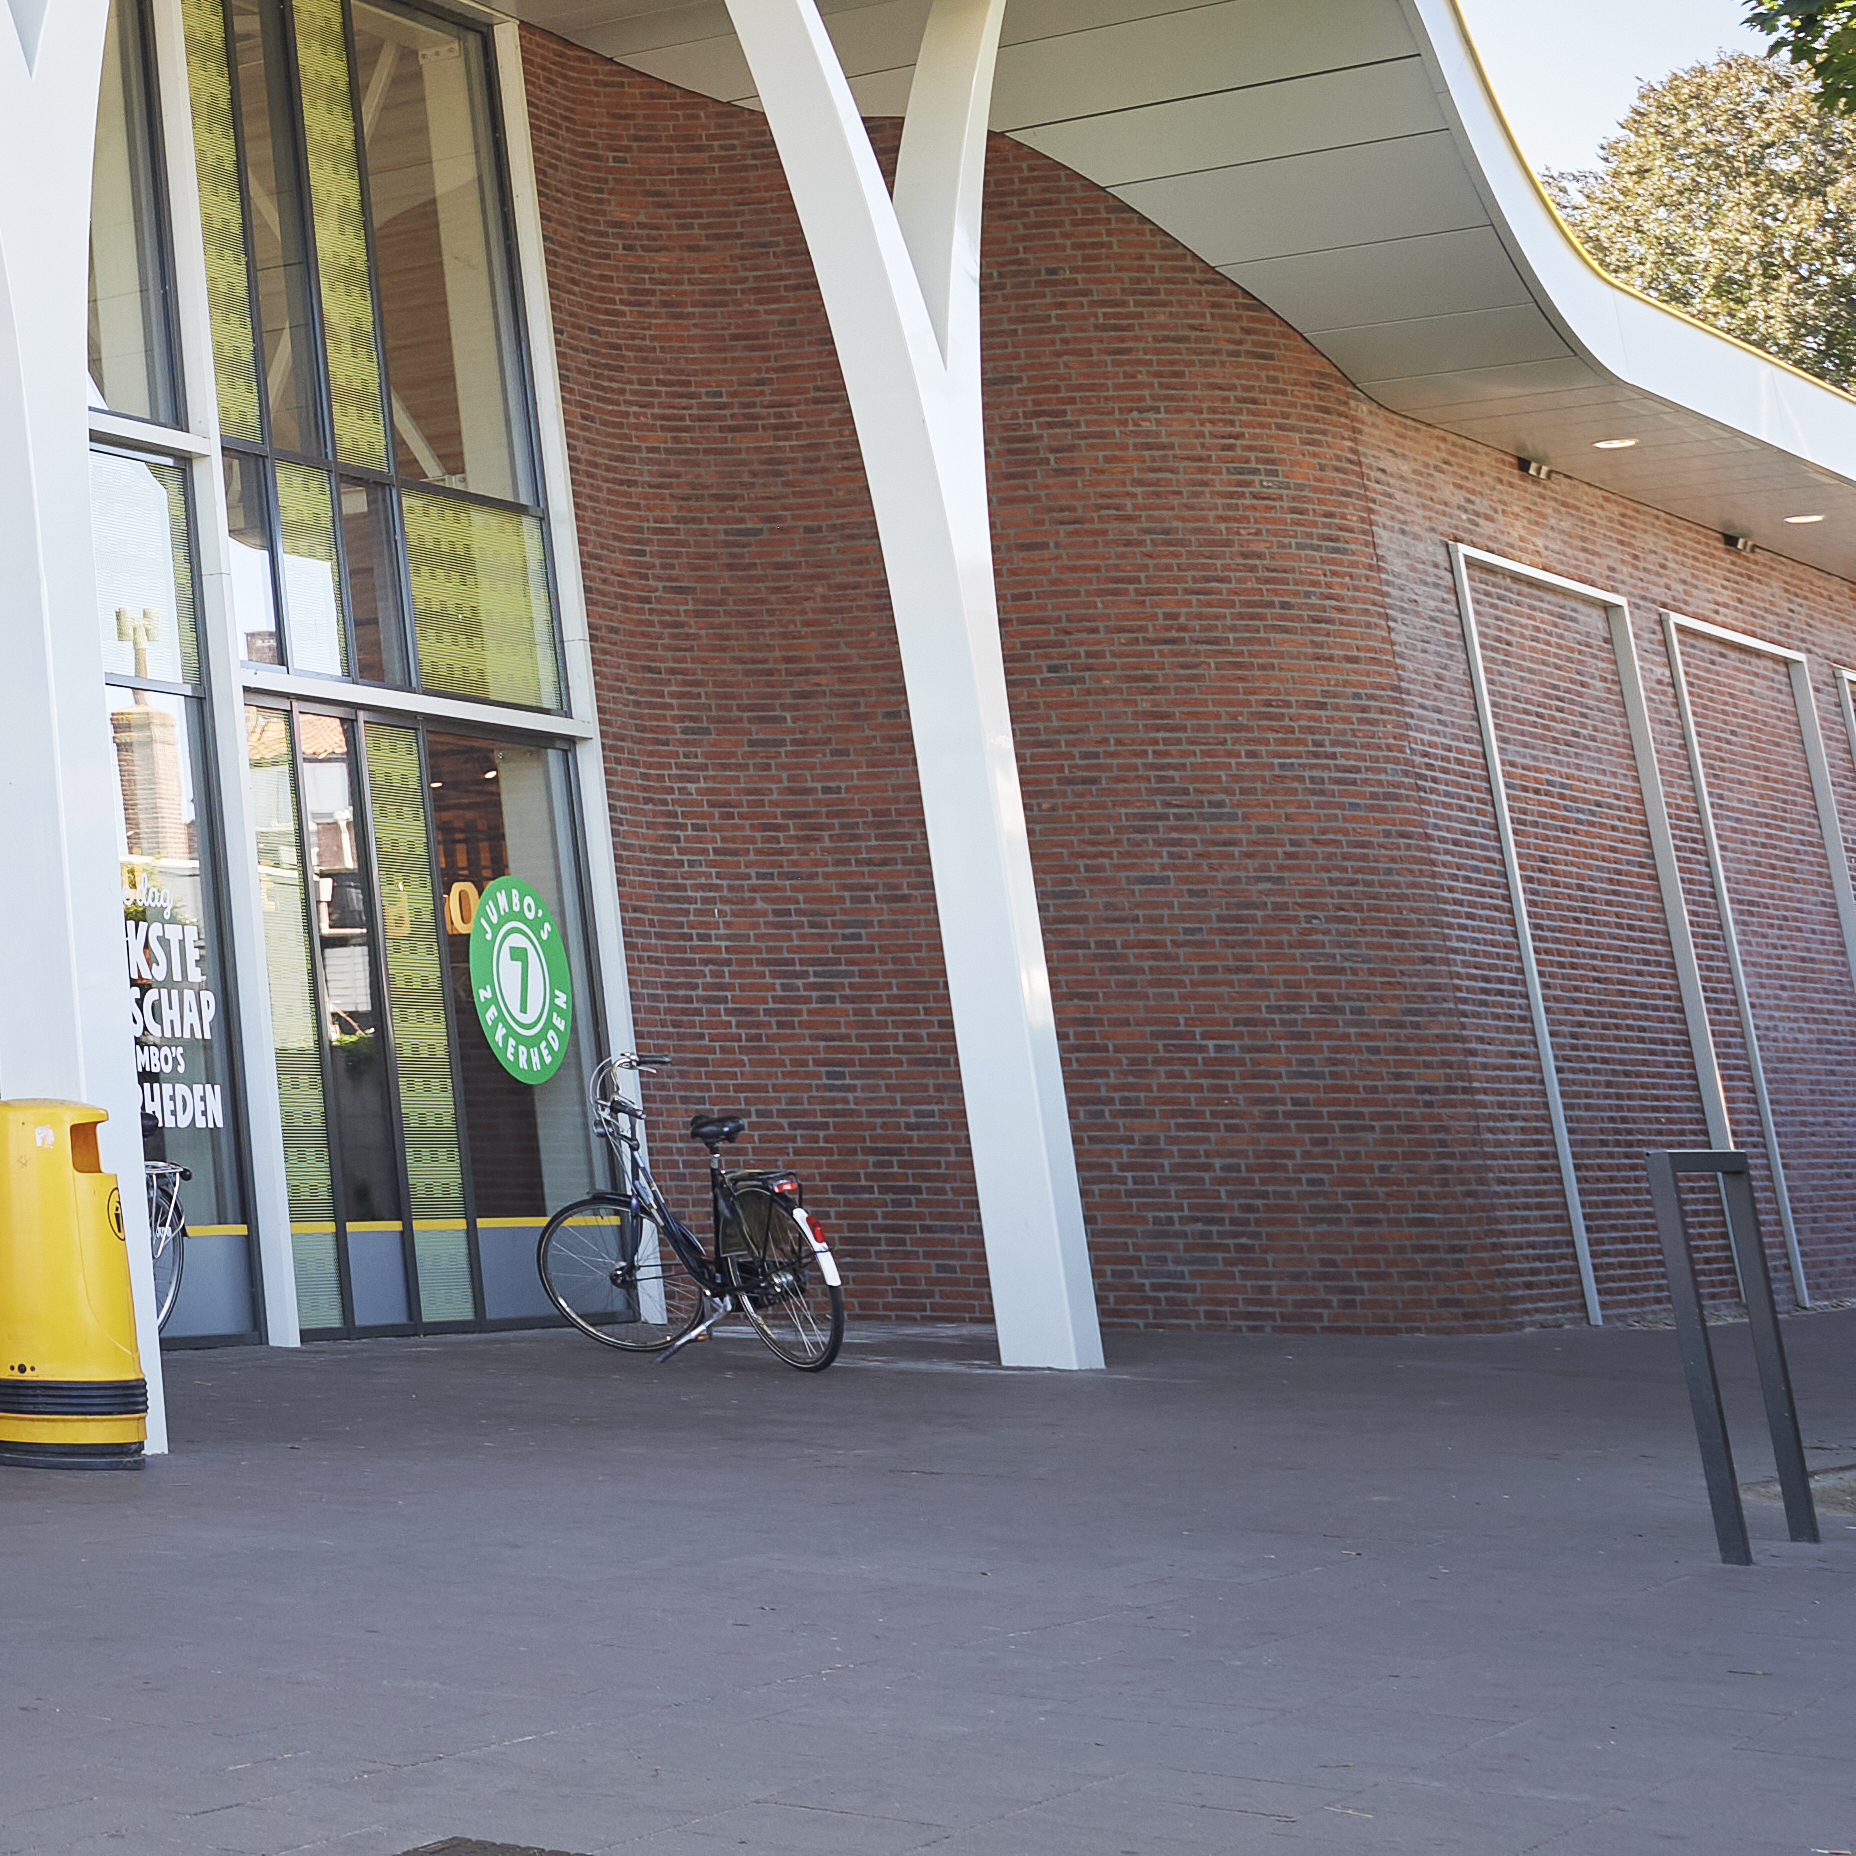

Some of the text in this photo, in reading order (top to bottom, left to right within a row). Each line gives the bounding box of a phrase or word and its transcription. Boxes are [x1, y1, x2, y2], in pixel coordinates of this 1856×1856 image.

[479, 888, 552, 942] JUMBO'S
[126, 920, 202, 983] KSTE
[508, 945, 529, 1015] 7
[478, 984, 568, 1072] ZEKERHEDEN
